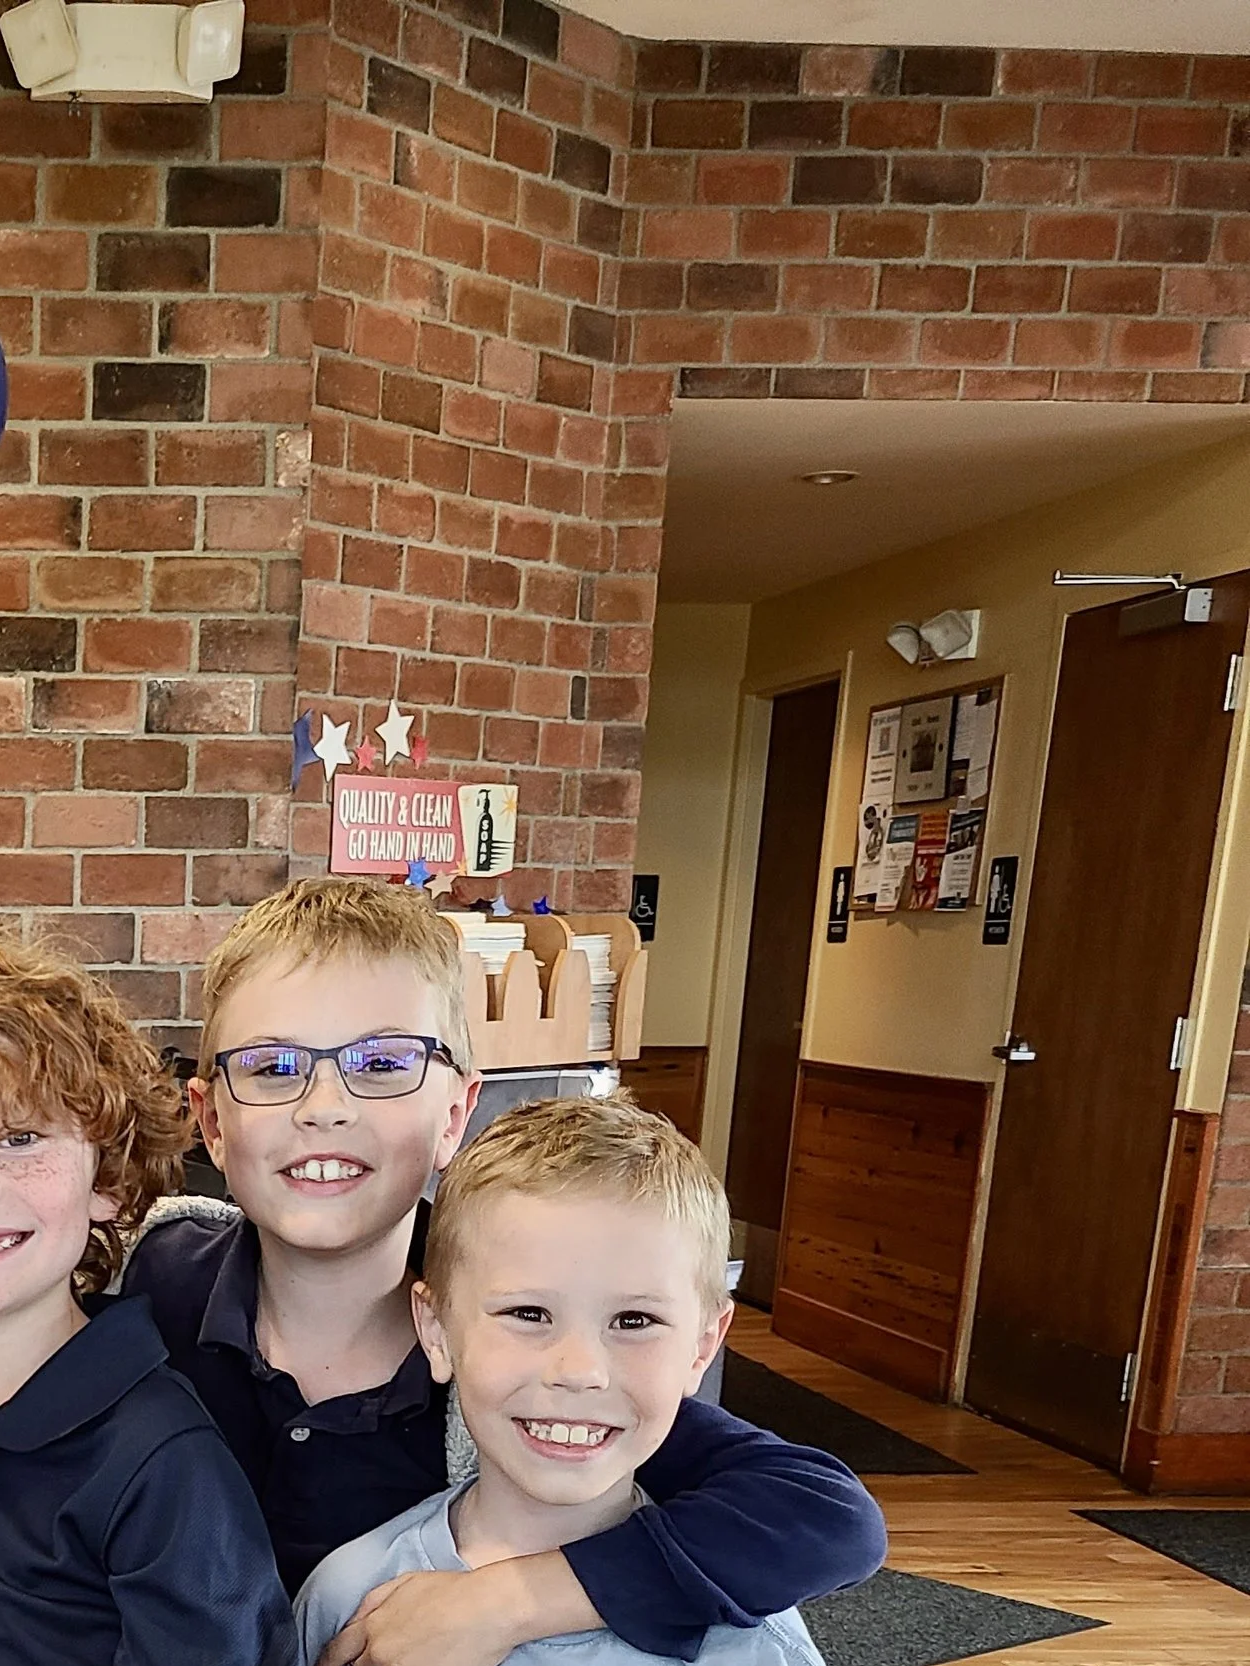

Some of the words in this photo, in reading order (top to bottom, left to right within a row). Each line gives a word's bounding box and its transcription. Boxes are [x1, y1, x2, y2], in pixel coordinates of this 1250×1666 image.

[339, 789, 396, 829] QUALITY
[398, 796, 408, 827] &
[411, 793, 453, 828] CLEAN
[348, 829, 367, 861] GO
[370, 830, 402, 861] HAND
[406, 831, 420, 862] IN
[422, 832, 456, 863] HAND
[479, 819, 490, 864] SOAP
